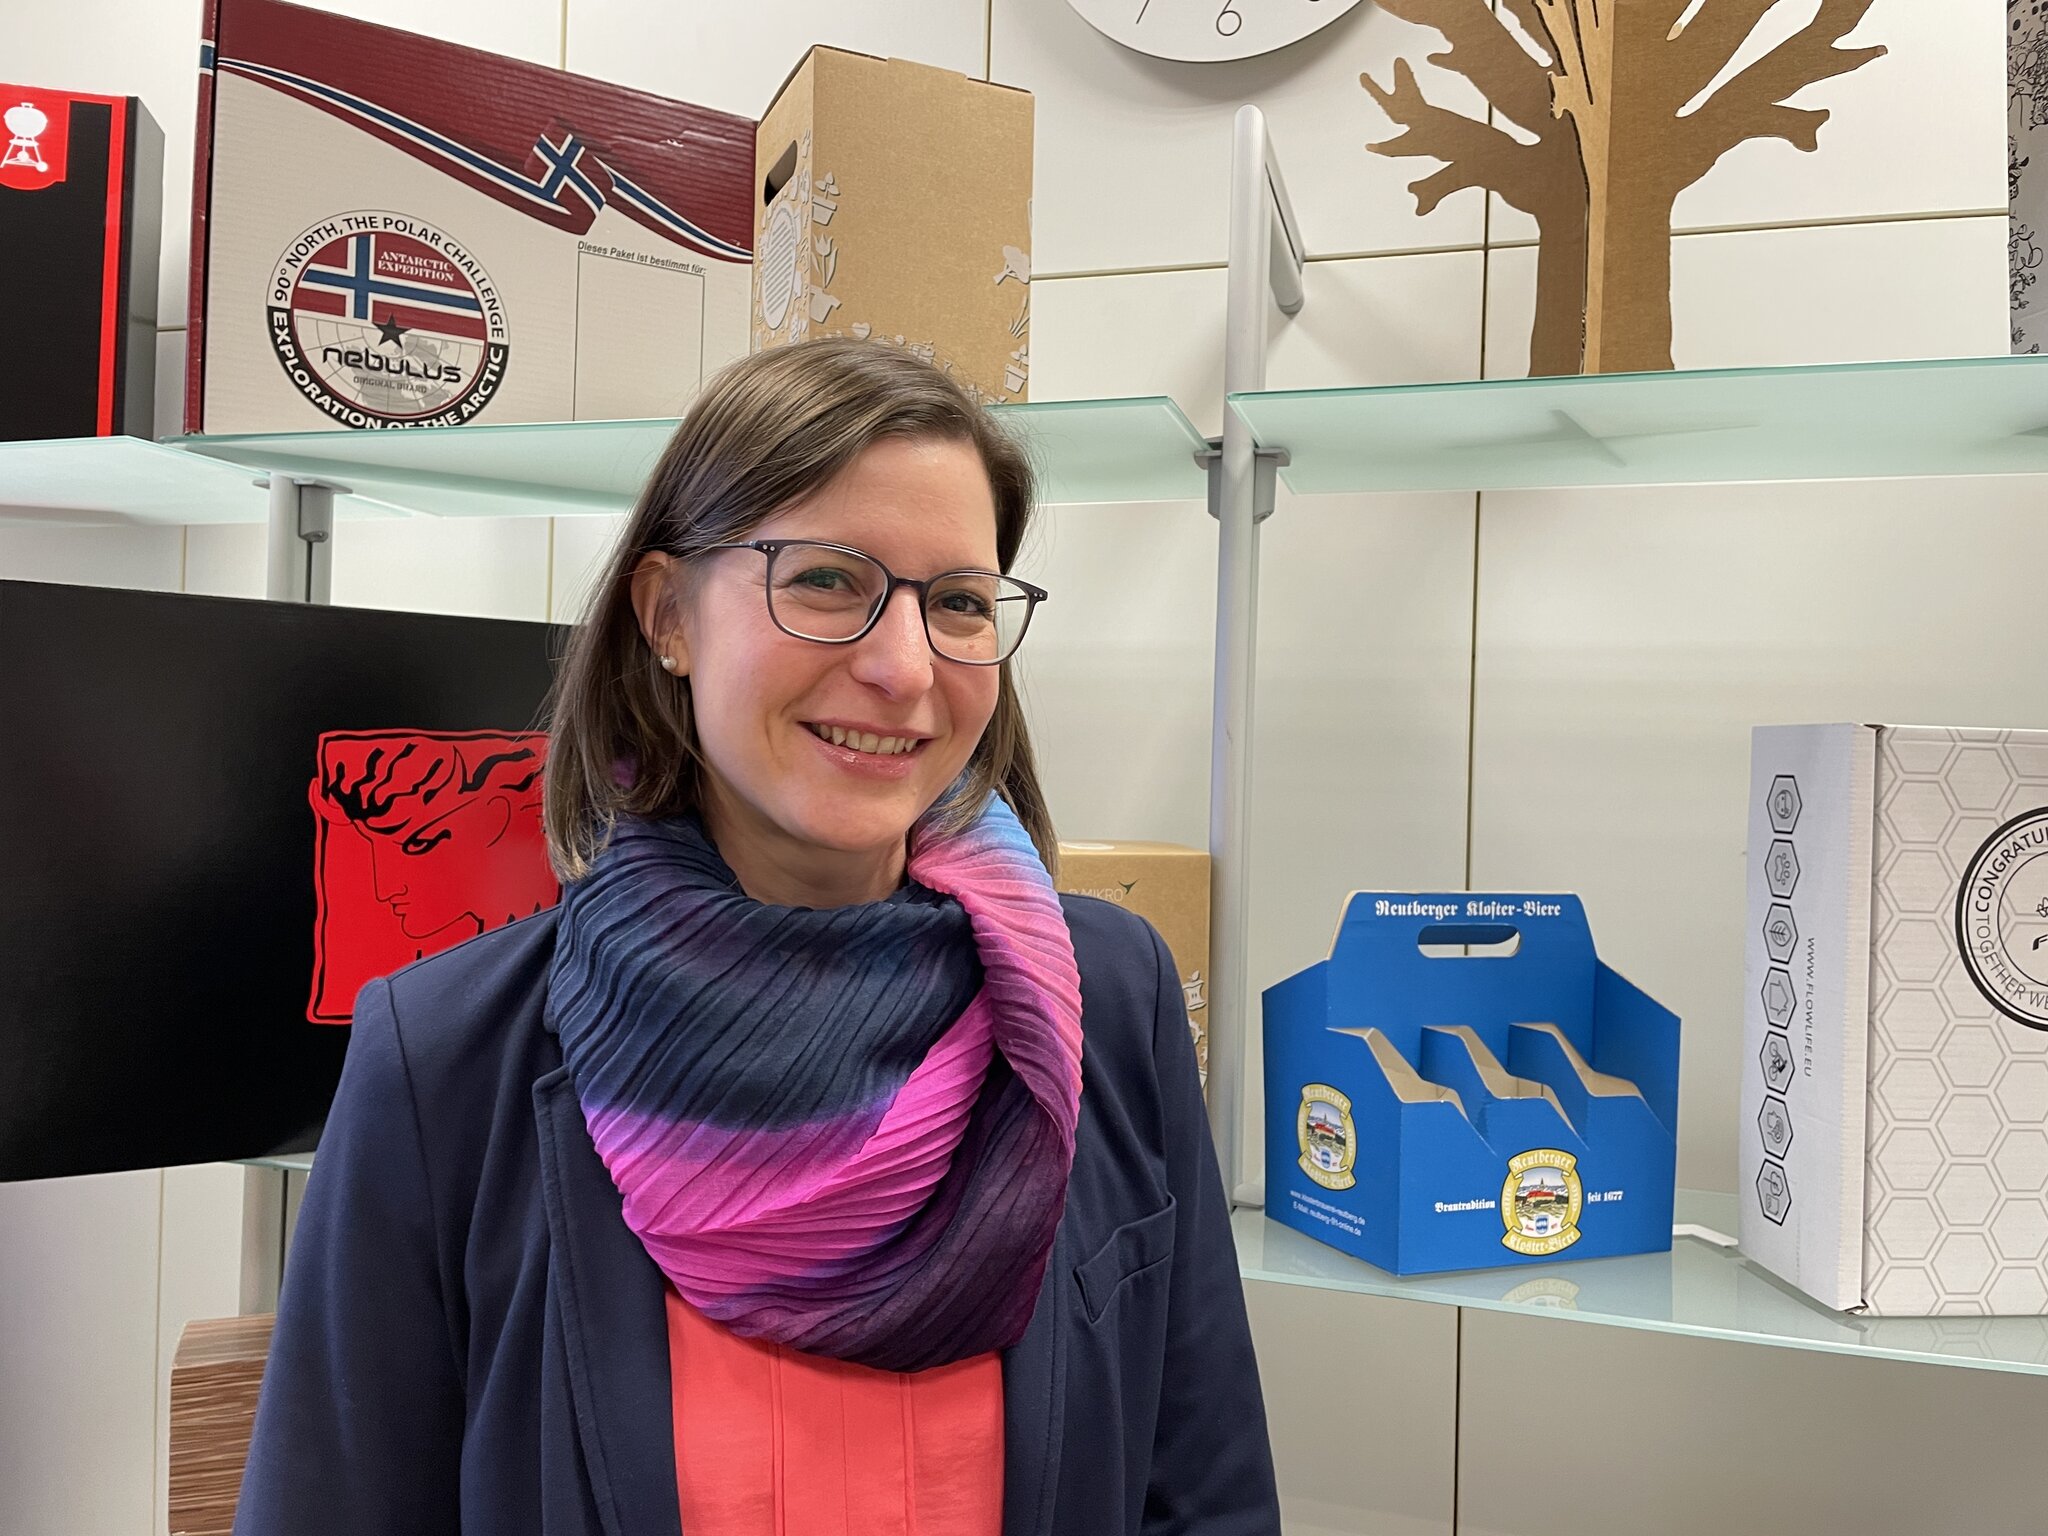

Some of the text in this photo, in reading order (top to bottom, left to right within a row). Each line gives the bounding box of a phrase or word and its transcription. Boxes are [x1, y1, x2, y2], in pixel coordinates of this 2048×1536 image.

[1217, 0, 1242, 36] 6
[378, 260, 454, 282] EXPEDITION
[381, 251, 452, 272] ANTARCTIC
[577, 240, 707, 275] Dieses Paket ist bestimmt für:
[274, 216, 504, 339] 90° NORTH, THE POLAR CHALLENGE
[273, 311, 382, 430] EXPLORATION
[418, 411, 461, 429] THE
[460, 347, 503, 418] ARCTIC
[353, 376, 395, 390] ORIGINAL
[1375, 900, 1458, 921] Reutberger
[1976, 914, 2026, 1000] TOGETHER
[1804, 937, 1815, 1078] WWW.FLOWLIFE.EU
[1434, 1197, 1496, 1213] Brautradition
[1604, 1191, 1623, 1202] 1677
